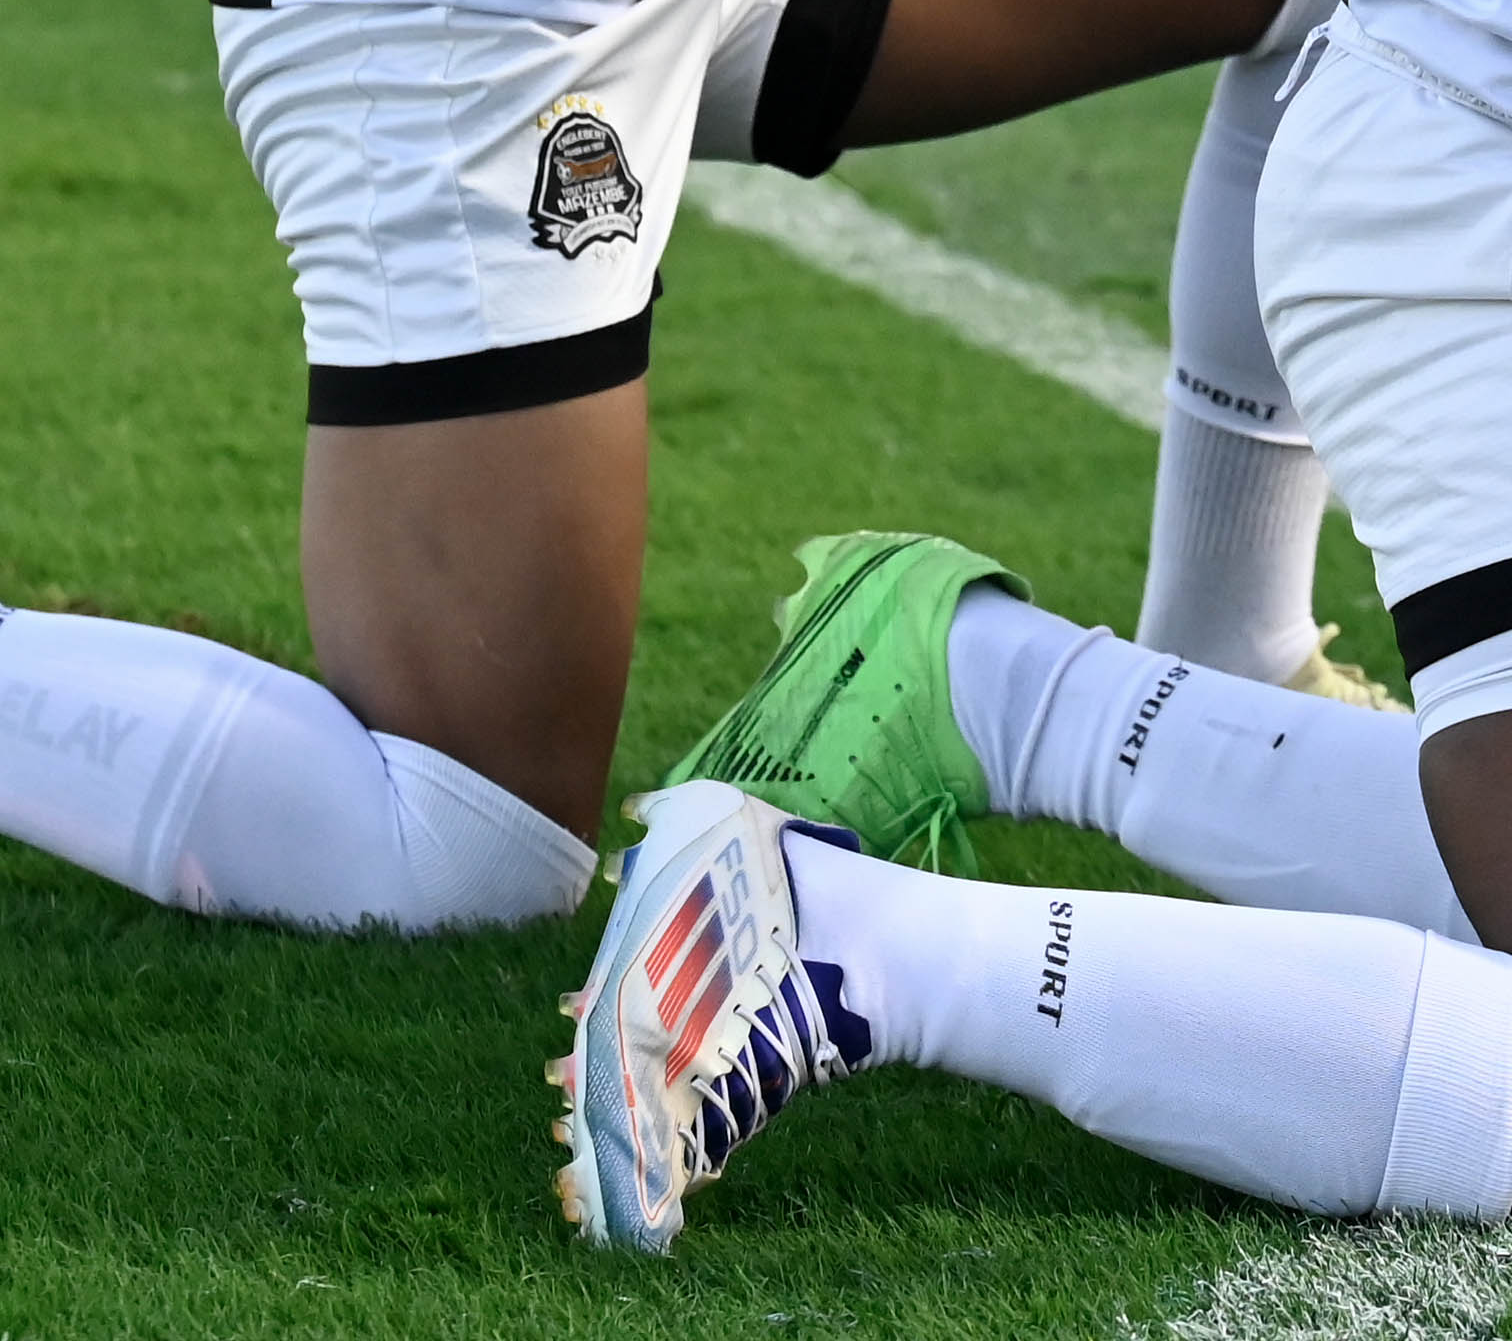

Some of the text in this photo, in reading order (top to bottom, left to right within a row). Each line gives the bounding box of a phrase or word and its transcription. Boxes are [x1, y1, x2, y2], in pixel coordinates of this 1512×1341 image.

[557, 184, 629, 215] MAZEMBE
[1118, 665, 1190, 777] SPORT
[714, 835, 759, 976] F50
[1037, 900, 1073, 1029] SPORT
